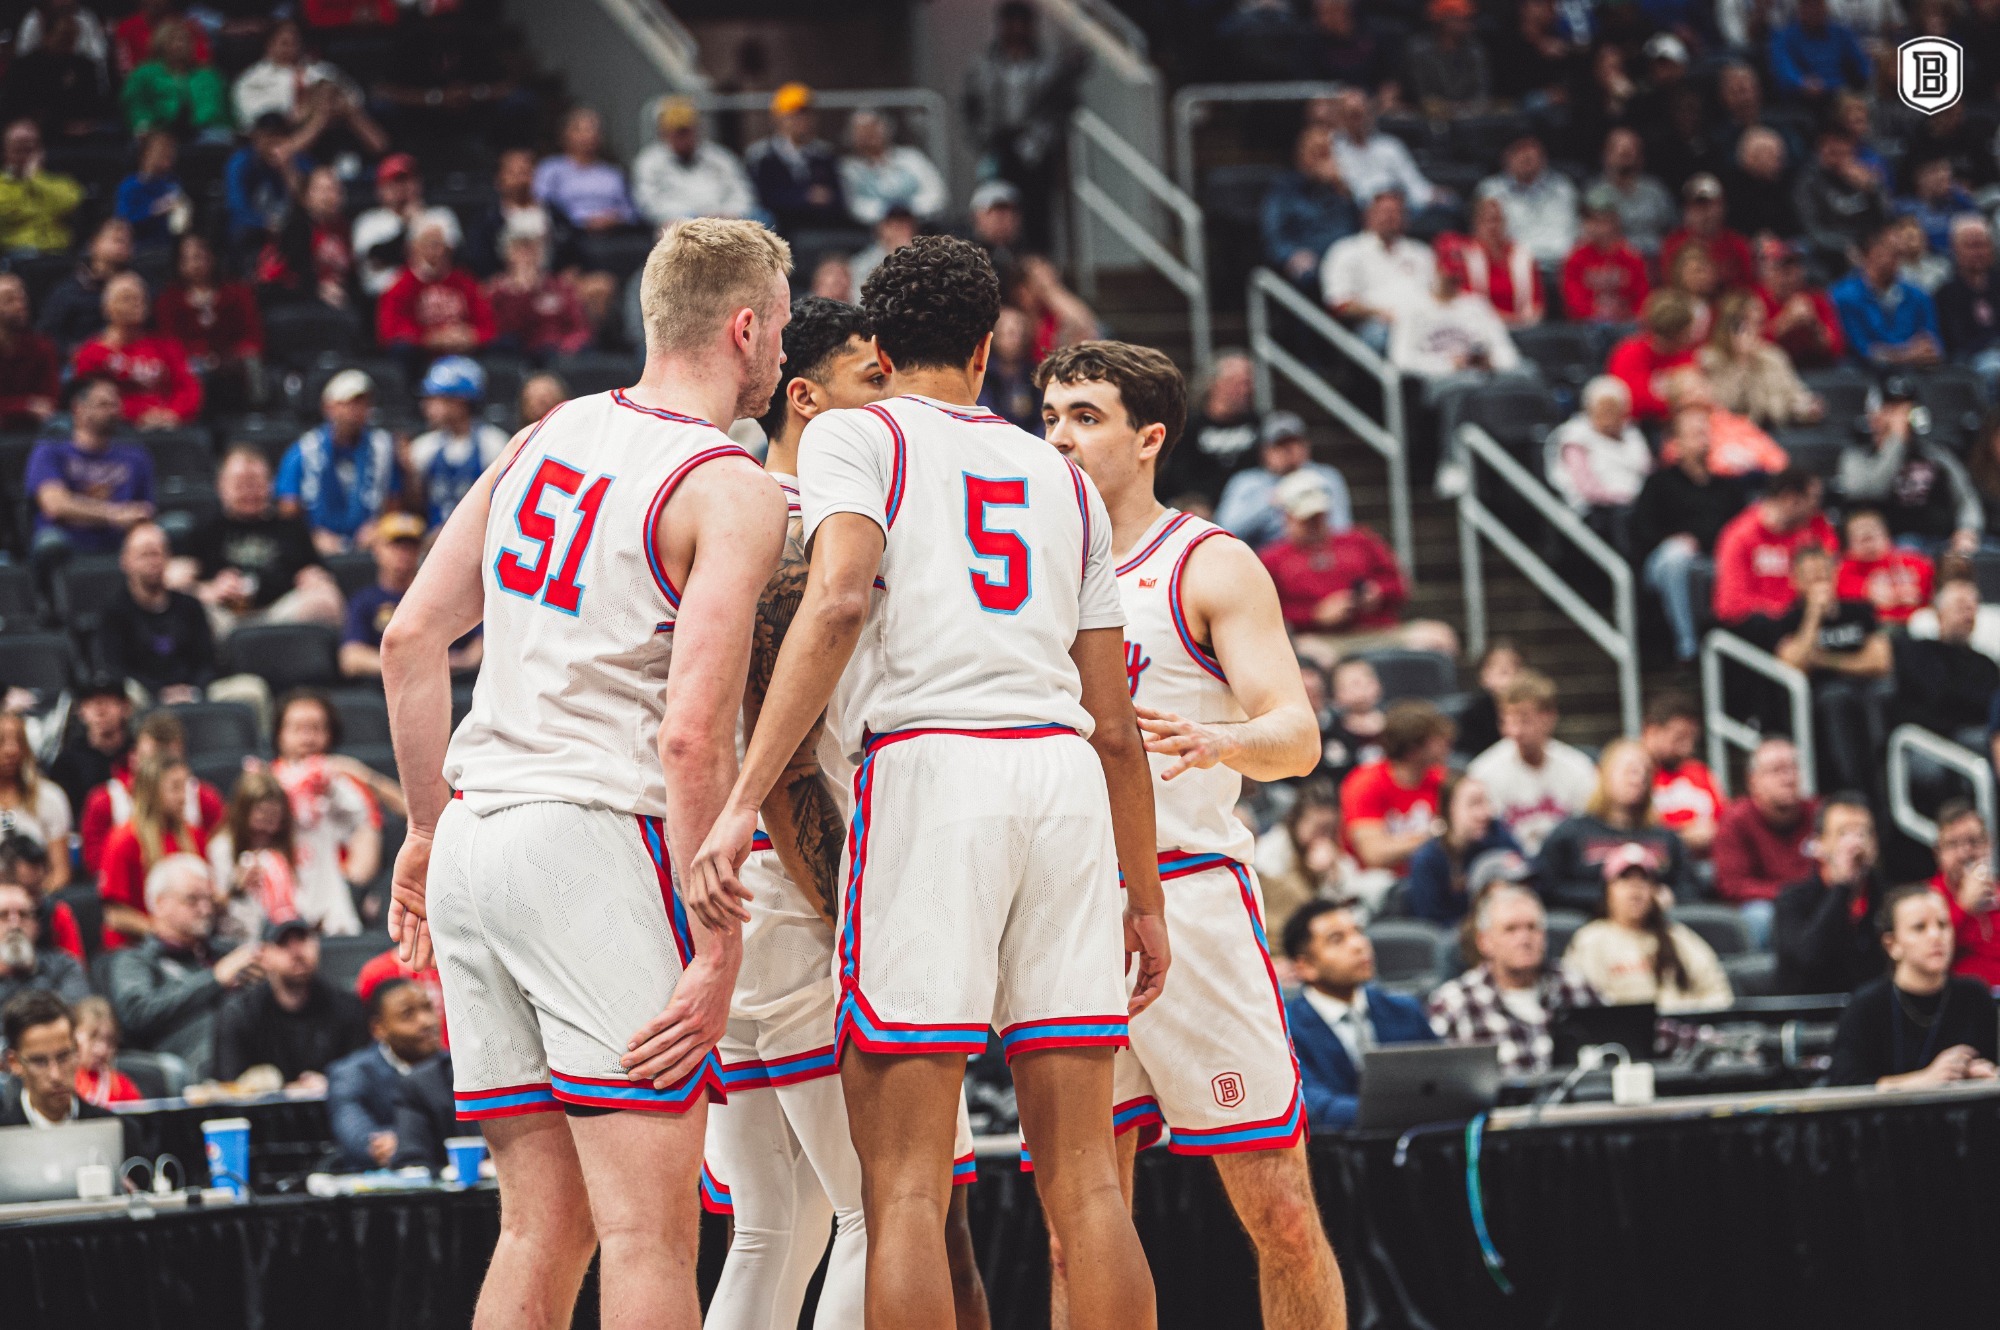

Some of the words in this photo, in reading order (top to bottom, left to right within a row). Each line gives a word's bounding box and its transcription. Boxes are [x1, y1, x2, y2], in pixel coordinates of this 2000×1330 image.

[493, 454, 617, 617] 51
[961, 470, 1032, 615] 5
[1218, 1077, 1239, 1102] B
